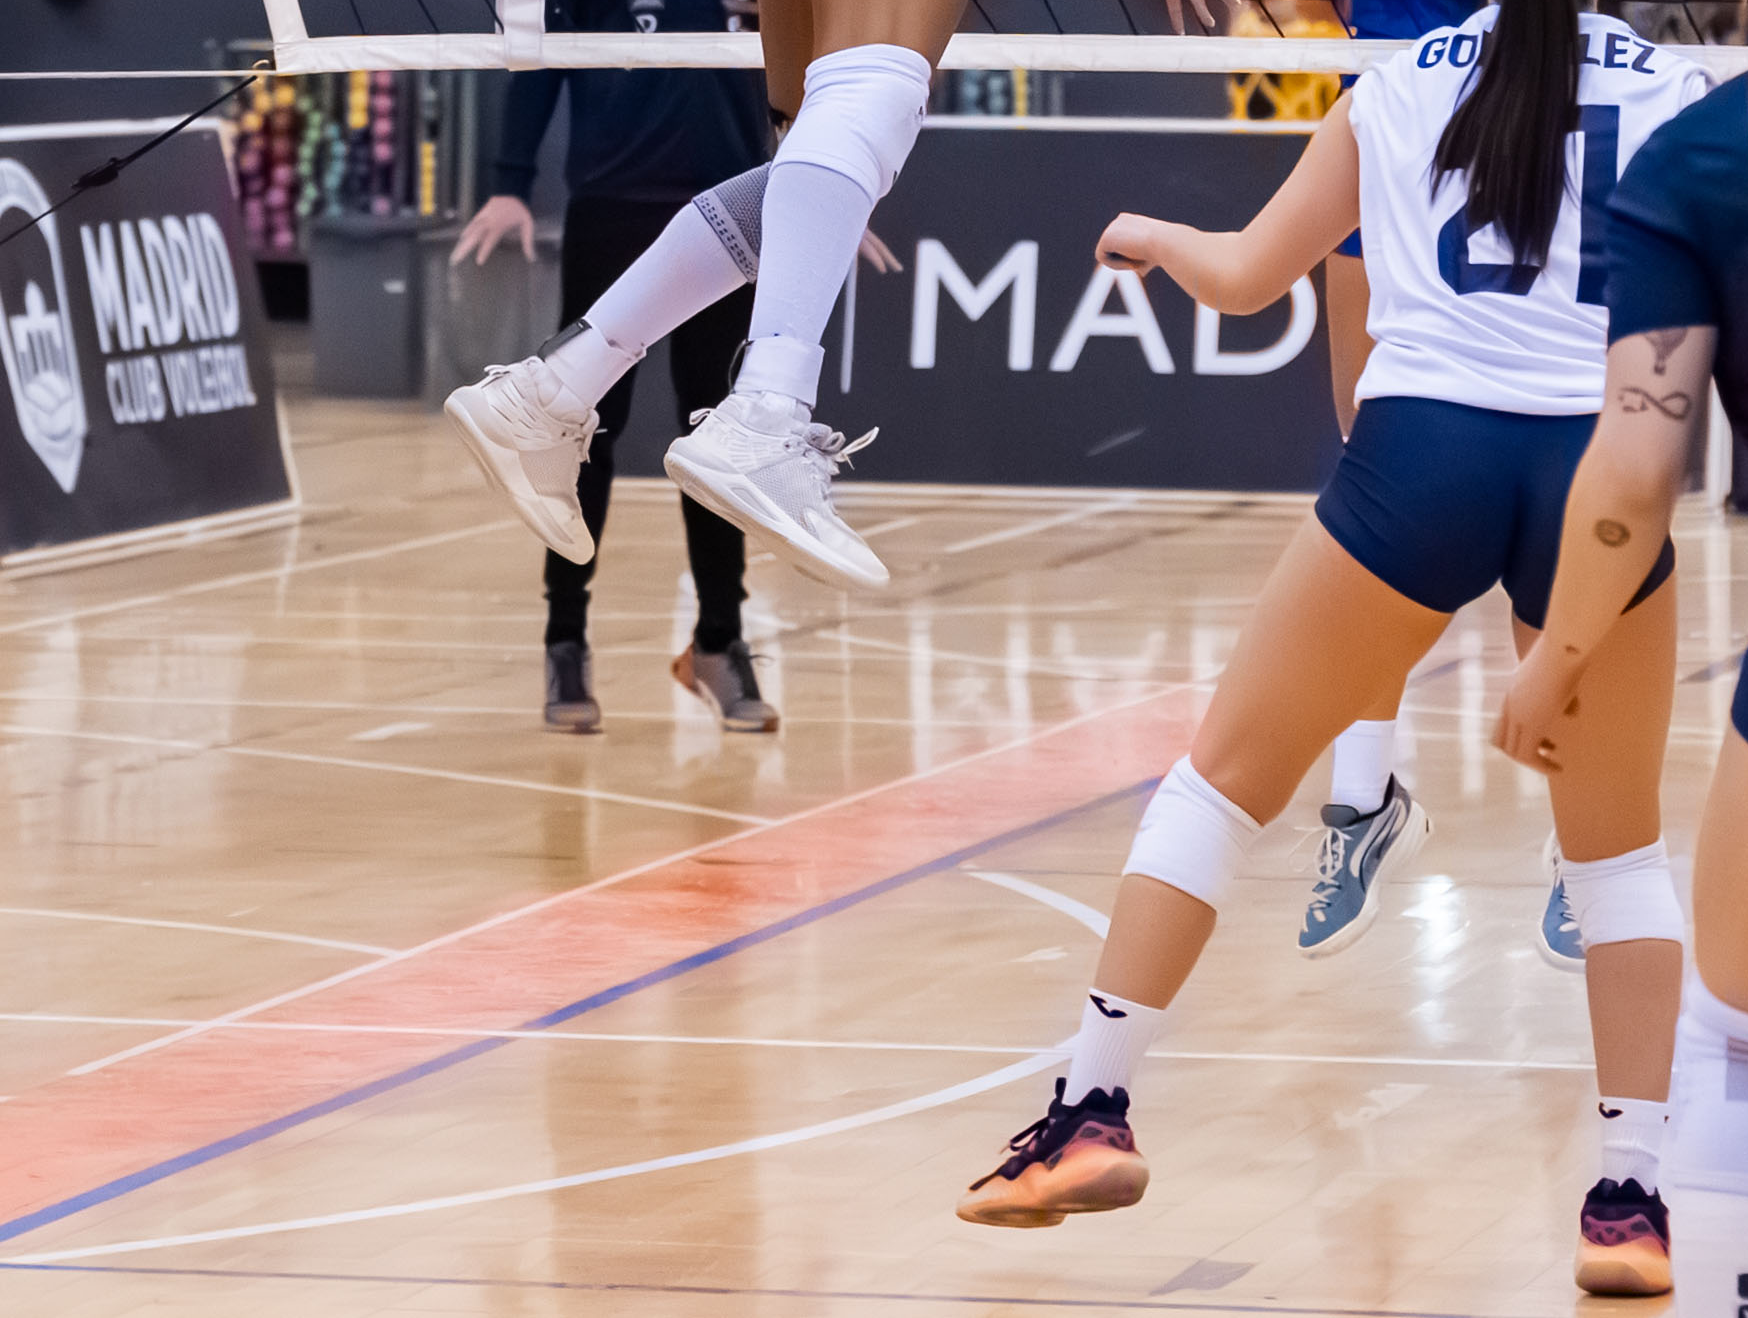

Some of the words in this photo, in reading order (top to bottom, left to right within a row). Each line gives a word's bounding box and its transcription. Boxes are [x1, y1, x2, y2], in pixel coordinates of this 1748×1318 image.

[1416, 33, 1656, 75] GOLEZ
[79, 213, 240, 354] MADRID
[105, 355, 167, 424] CLUB
